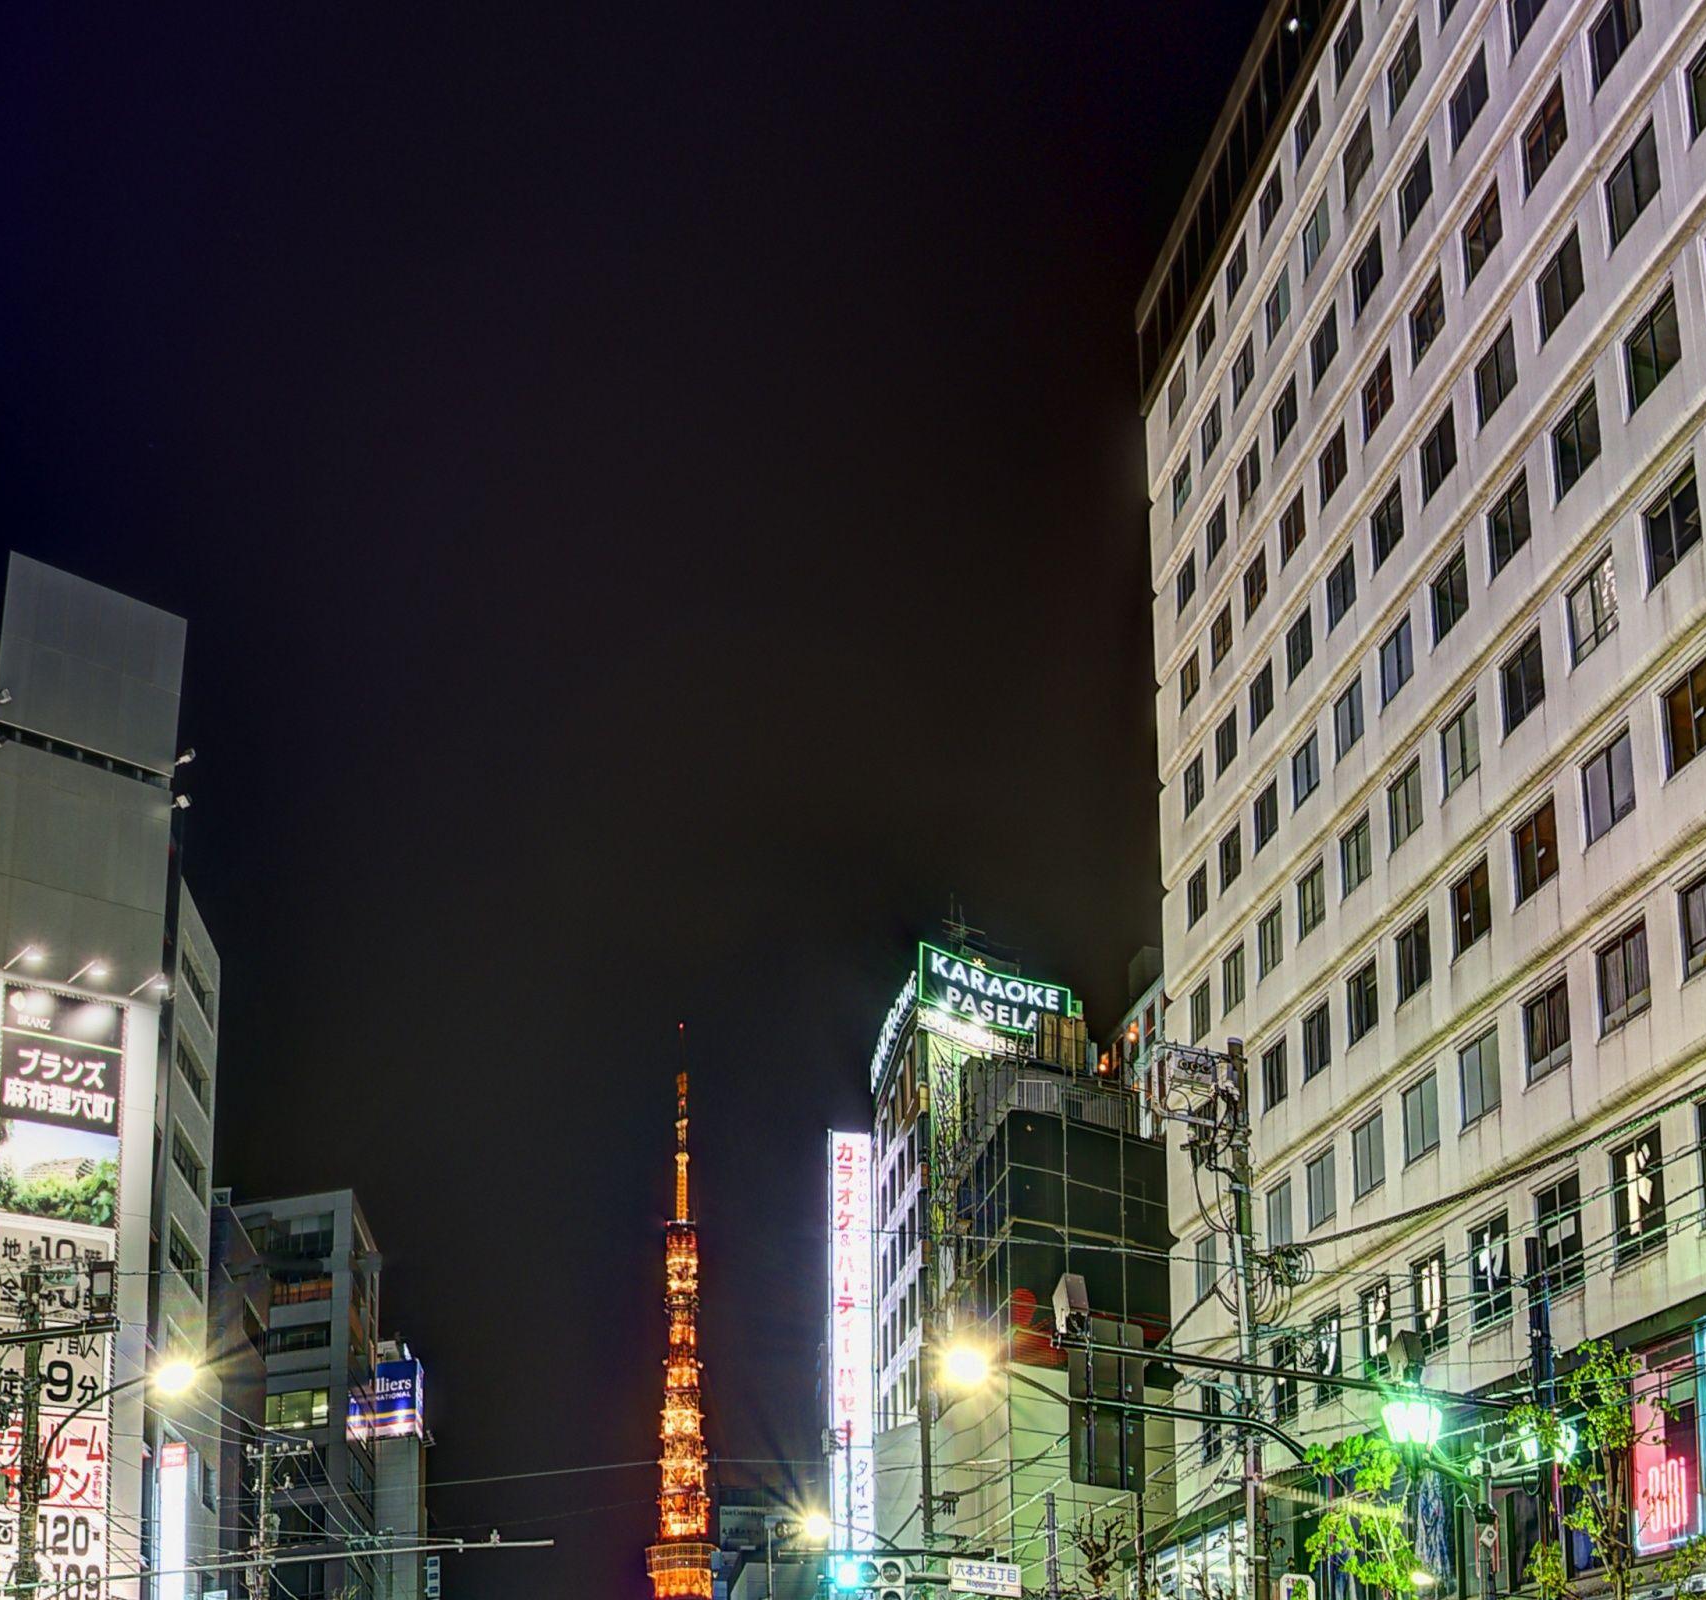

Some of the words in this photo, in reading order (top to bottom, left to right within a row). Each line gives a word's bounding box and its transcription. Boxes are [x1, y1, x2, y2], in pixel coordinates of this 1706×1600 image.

[931, 951, 1060, 1011] KARAOKE
[18, 1014, 51, 1031] BRANZ
[946, 986, 1038, 1031] PASELA
[18, 1048, 106, 1090] ブランズ
[376, 1376, 413, 1394] lliers
[954, 1562, 1017, 1583] 六本木五丁目
